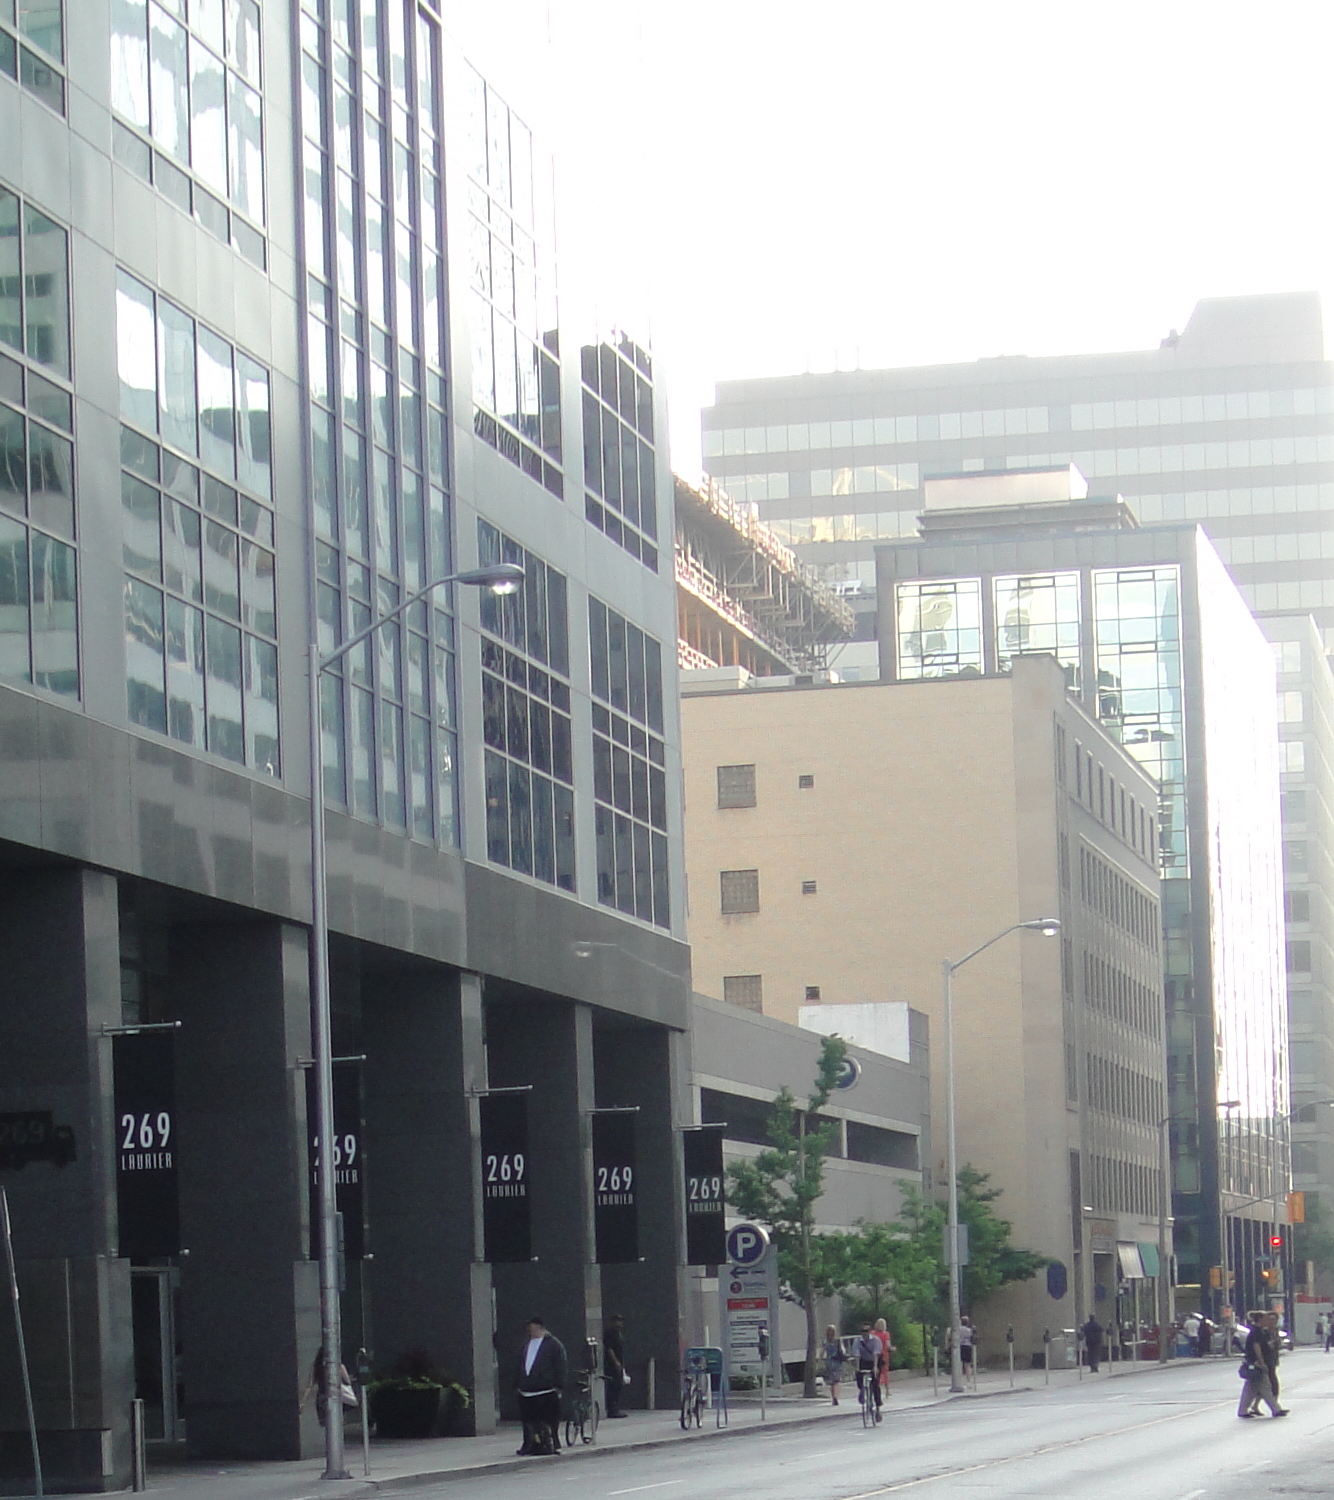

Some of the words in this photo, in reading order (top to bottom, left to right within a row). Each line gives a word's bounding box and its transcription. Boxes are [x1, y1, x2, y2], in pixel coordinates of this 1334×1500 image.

[121, 1112, 170, 1149] 269
[121, 1152, 172, 1171] LAURIER
[486, 1153, 525, 1181] 269
[313, 1169, 359, 1185] LRIER
[598, 1166, 632, 1191] 269
[689, 1177, 721, 1200] 269
[736, 1232, 757, 1258] P
